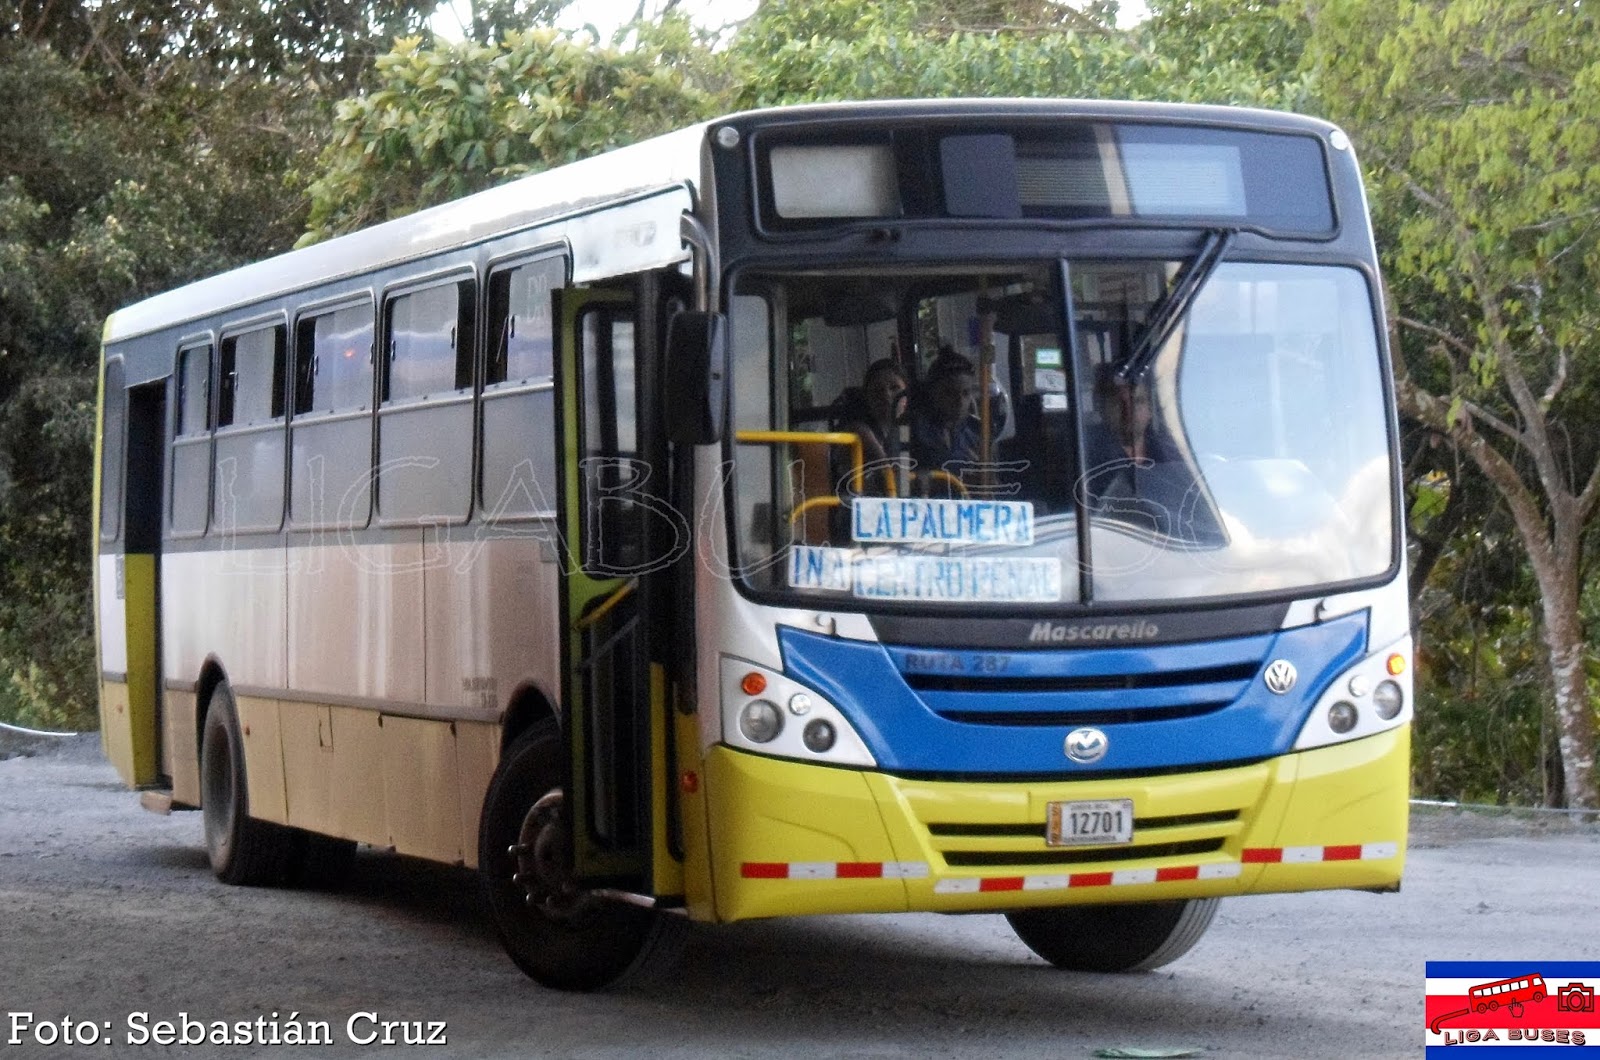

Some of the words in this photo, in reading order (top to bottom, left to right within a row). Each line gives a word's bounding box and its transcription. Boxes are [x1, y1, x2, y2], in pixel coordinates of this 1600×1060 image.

[856, 502, 893, 538] LA
[901, 502, 1029, 542] PALMERA
[1029, 620, 1159, 642] Mascarello
[905, 653, 965, 671] RUTA
[973, 654, 1010, 672] 287
[1070, 811, 1123, 835] 12701
